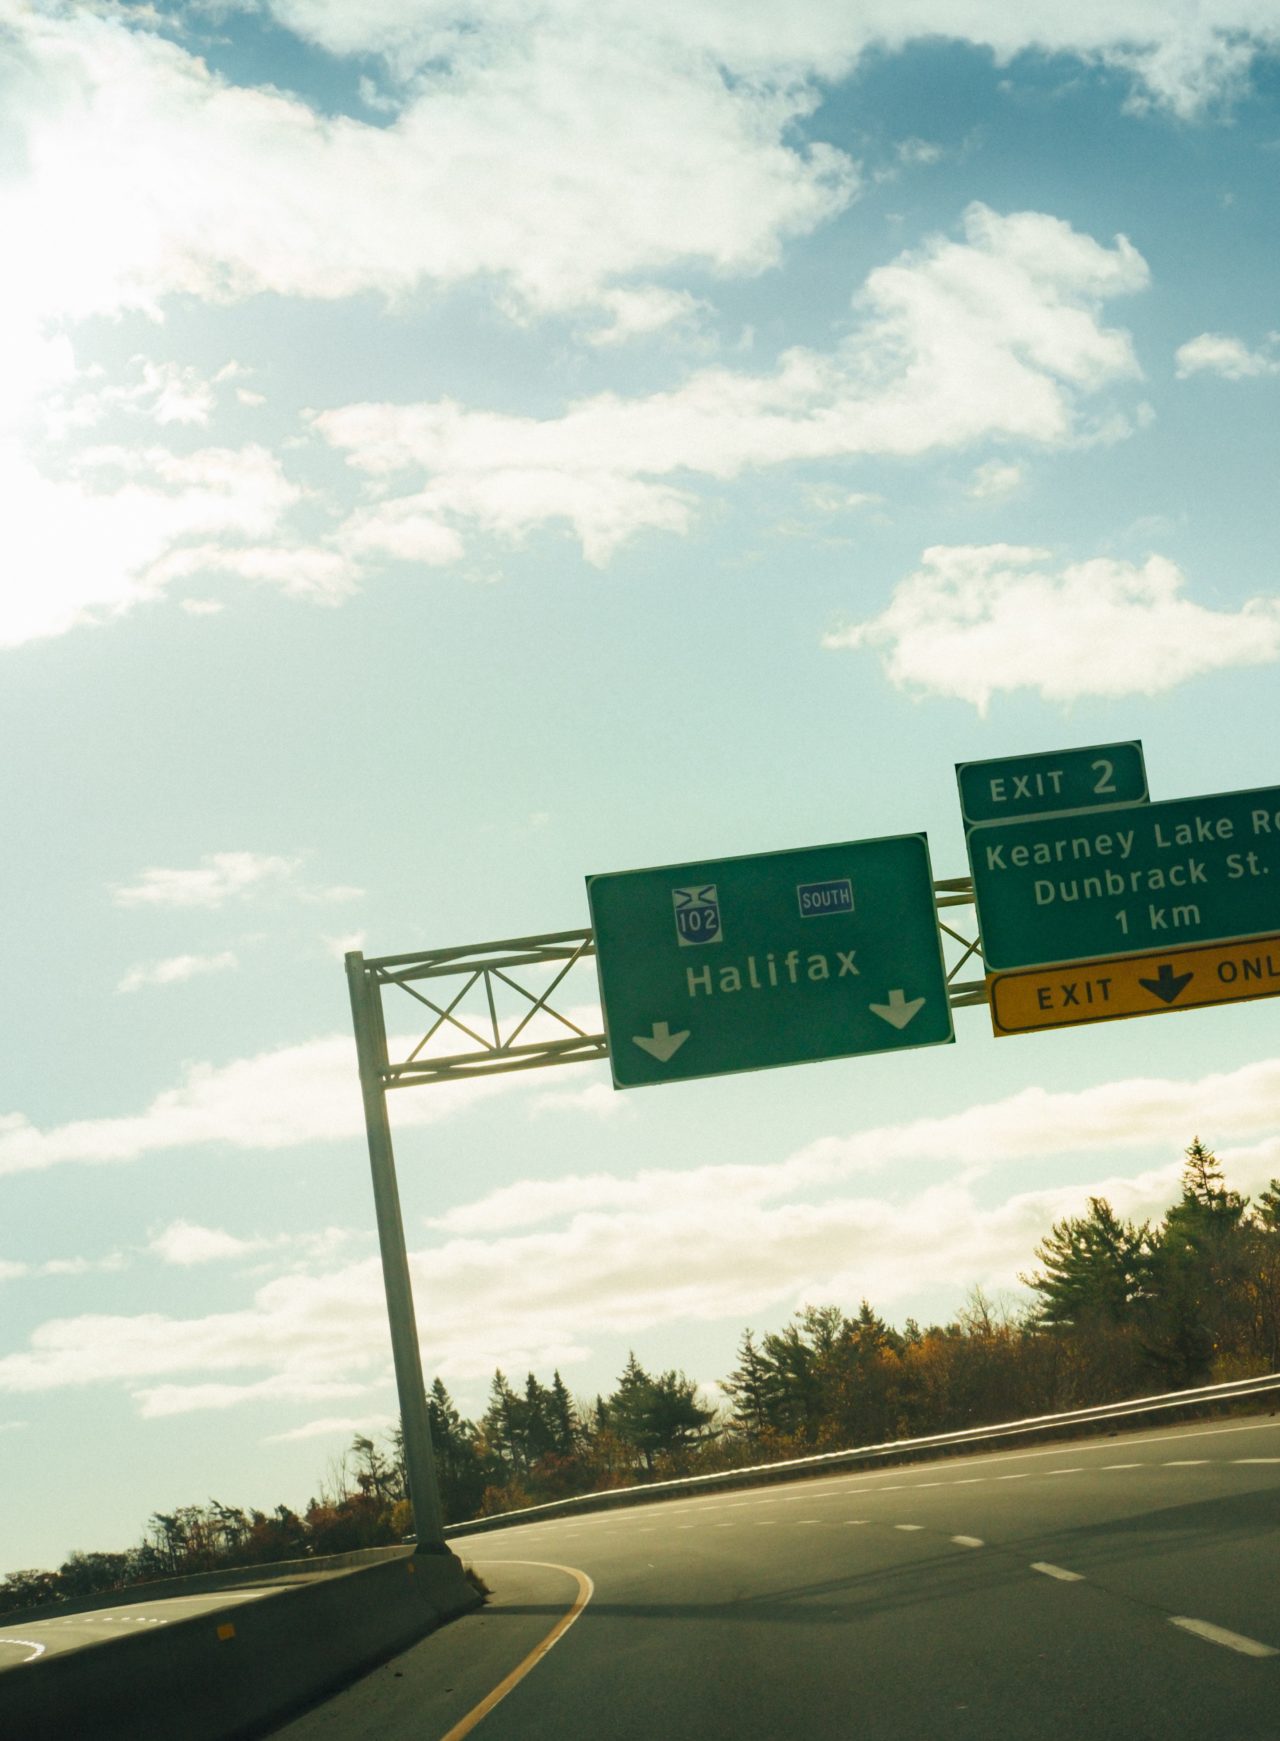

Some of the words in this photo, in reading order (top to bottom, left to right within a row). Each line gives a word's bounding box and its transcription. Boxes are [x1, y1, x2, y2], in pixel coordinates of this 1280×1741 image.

[990, 771, 1064, 802] EXIT
[1091, 759, 1117, 794] 2
[986, 830, 1135, 870] Kearney
[1154, 815, 1234, 848] Lake
[1034, 859, 1208, 906] Dunbrack
[1226, 851, 1270, 879] St.
[802, 888, 850, 909] SOUTH
[679, 909, 717, 933] 102
[1115, 909, 1129, 935] 1
[1149, 903, 1201, 930] km
[686, 950, 861, 997] Halifax
[1038, 978, 1112, 1011] EXIT
